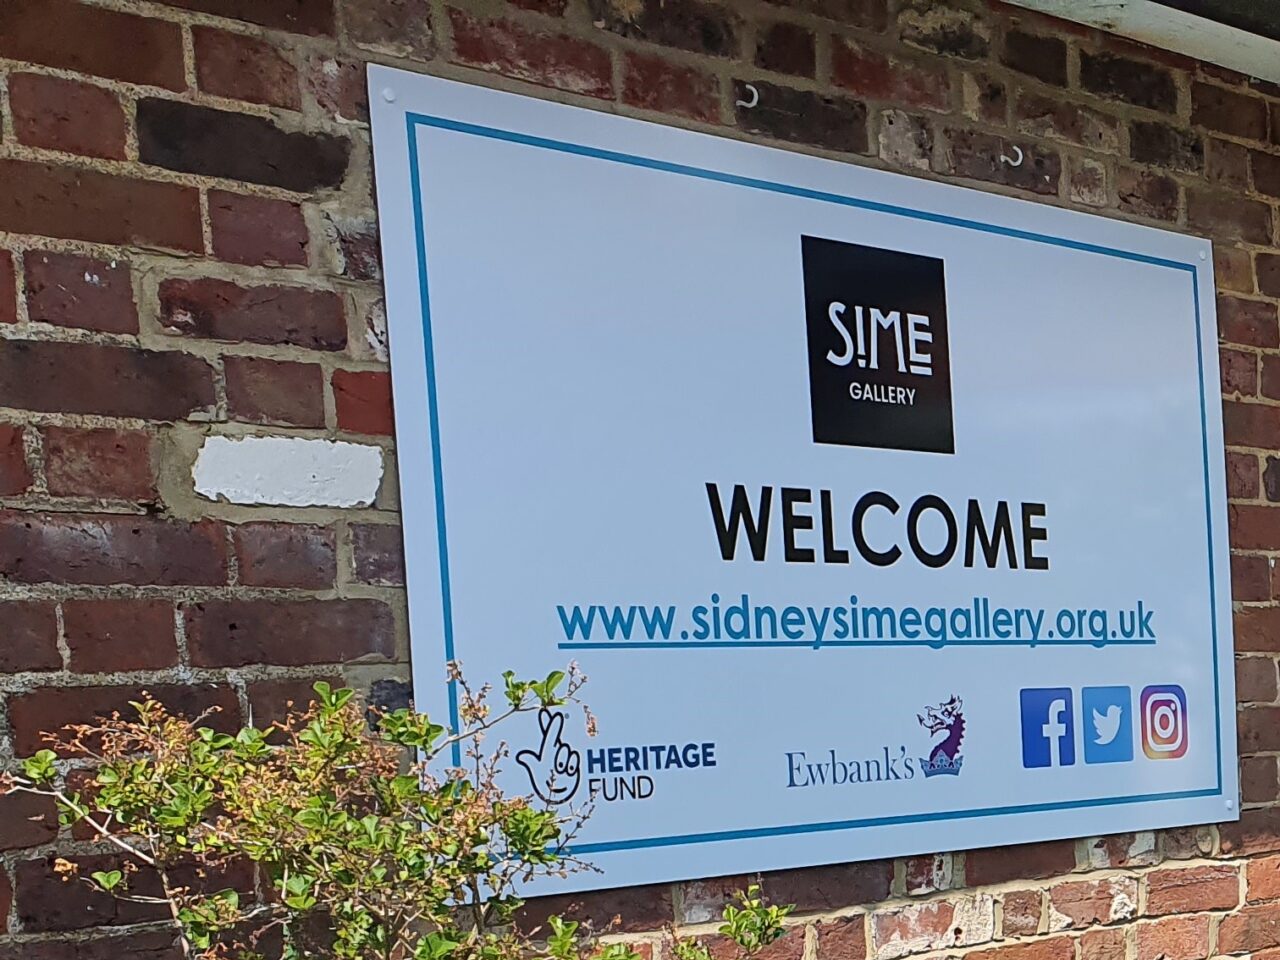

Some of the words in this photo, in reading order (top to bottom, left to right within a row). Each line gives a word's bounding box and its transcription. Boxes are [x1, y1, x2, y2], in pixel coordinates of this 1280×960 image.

[826, 301, 933, 376] SIME
[849, 382, 916, 405] GALLERY
[704, 482, 1050, 570] WELCOME
[556, 593, 1157, 650] www.sidneysimegallery.org.uk
[587, 743, 717, 774] HERITAGE
[784, 745, 915, 788] Ewbank's
[588, 775, 654, 802] FUND
